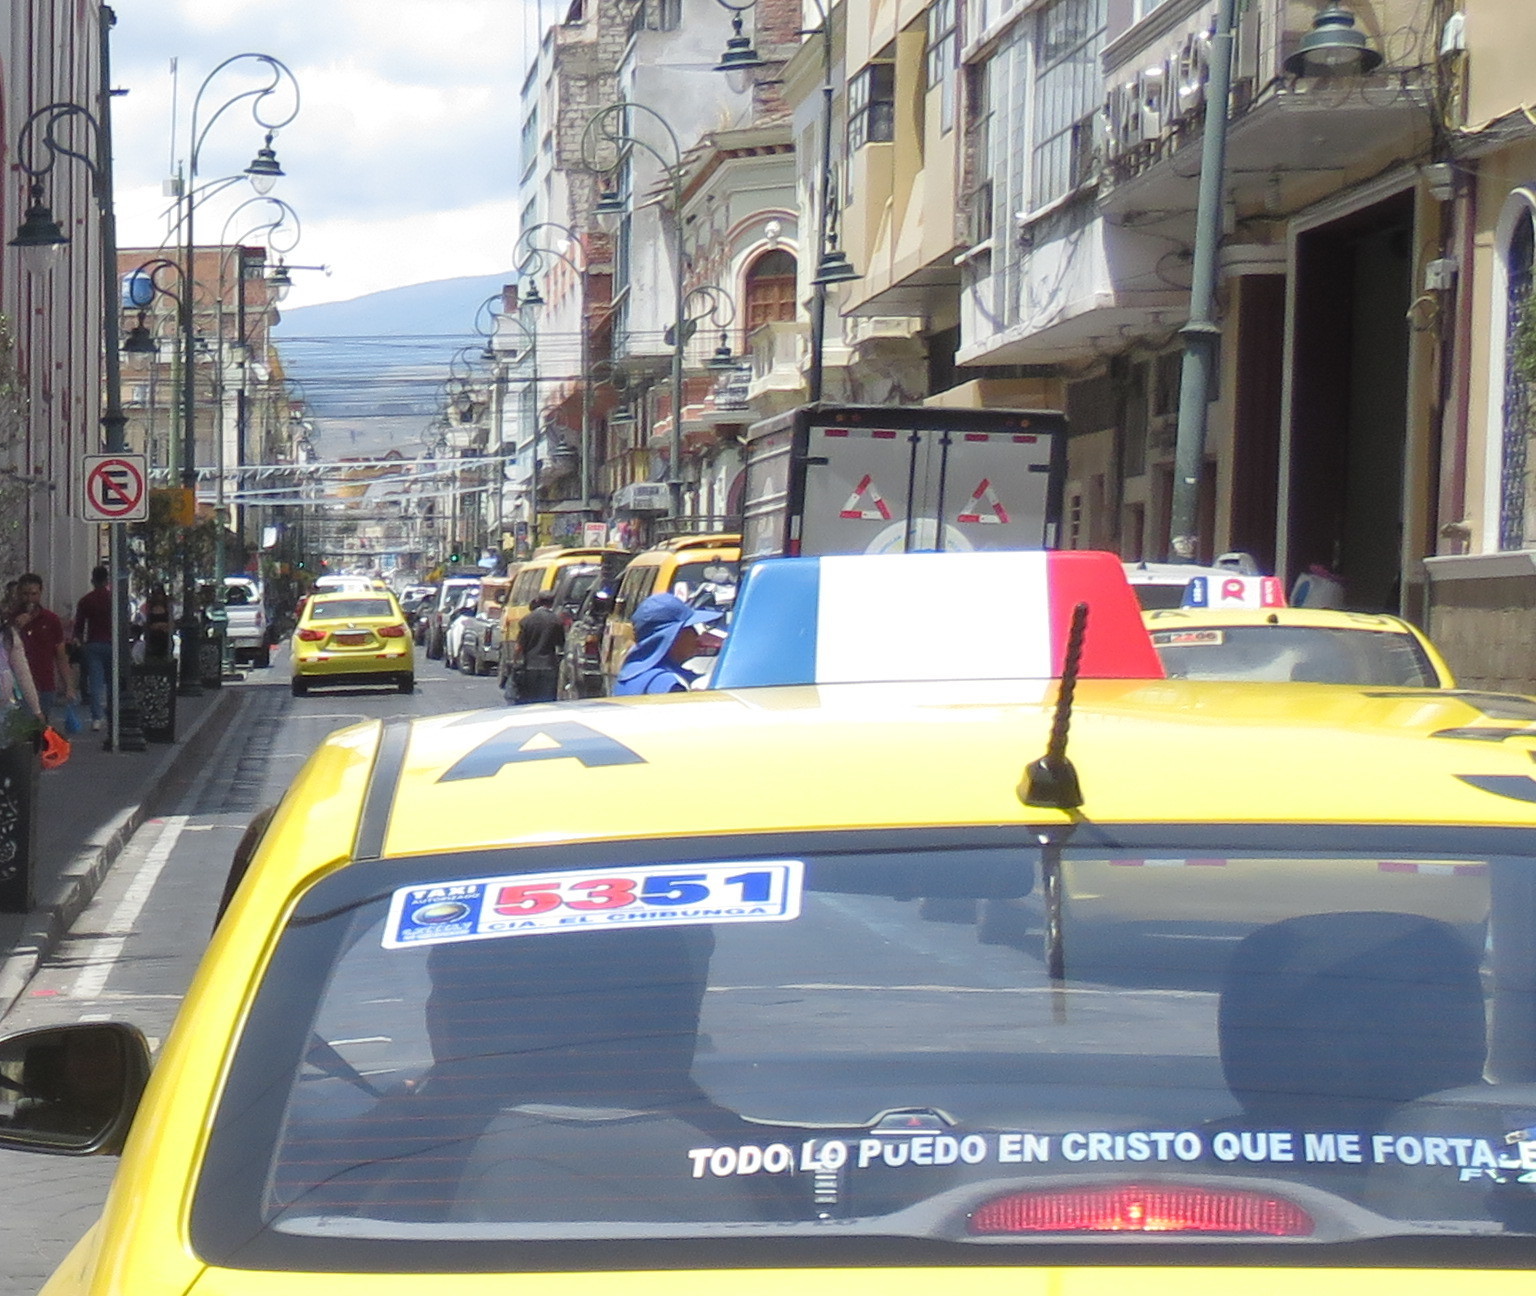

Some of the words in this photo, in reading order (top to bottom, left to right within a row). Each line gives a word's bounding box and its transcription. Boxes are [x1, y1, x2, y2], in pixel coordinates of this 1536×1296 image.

[494, 871, 774, 916] 5351
[558, 914, 598, 926] EL
[606, 907, 769, 922] CHIBUNGA
[687, 1143, 791, 1178] TODO
[800, 1138, 848, 1172] LO
[858, 1135, 986, 1169] PUEDO
[998, 1135, 1050, 1163] EN
[1061, 1131, 1202, 1162] CRISTO
[1213, 1131, 1294, 1163] QUE
[1305, 1133, 1363, 1163] ME
